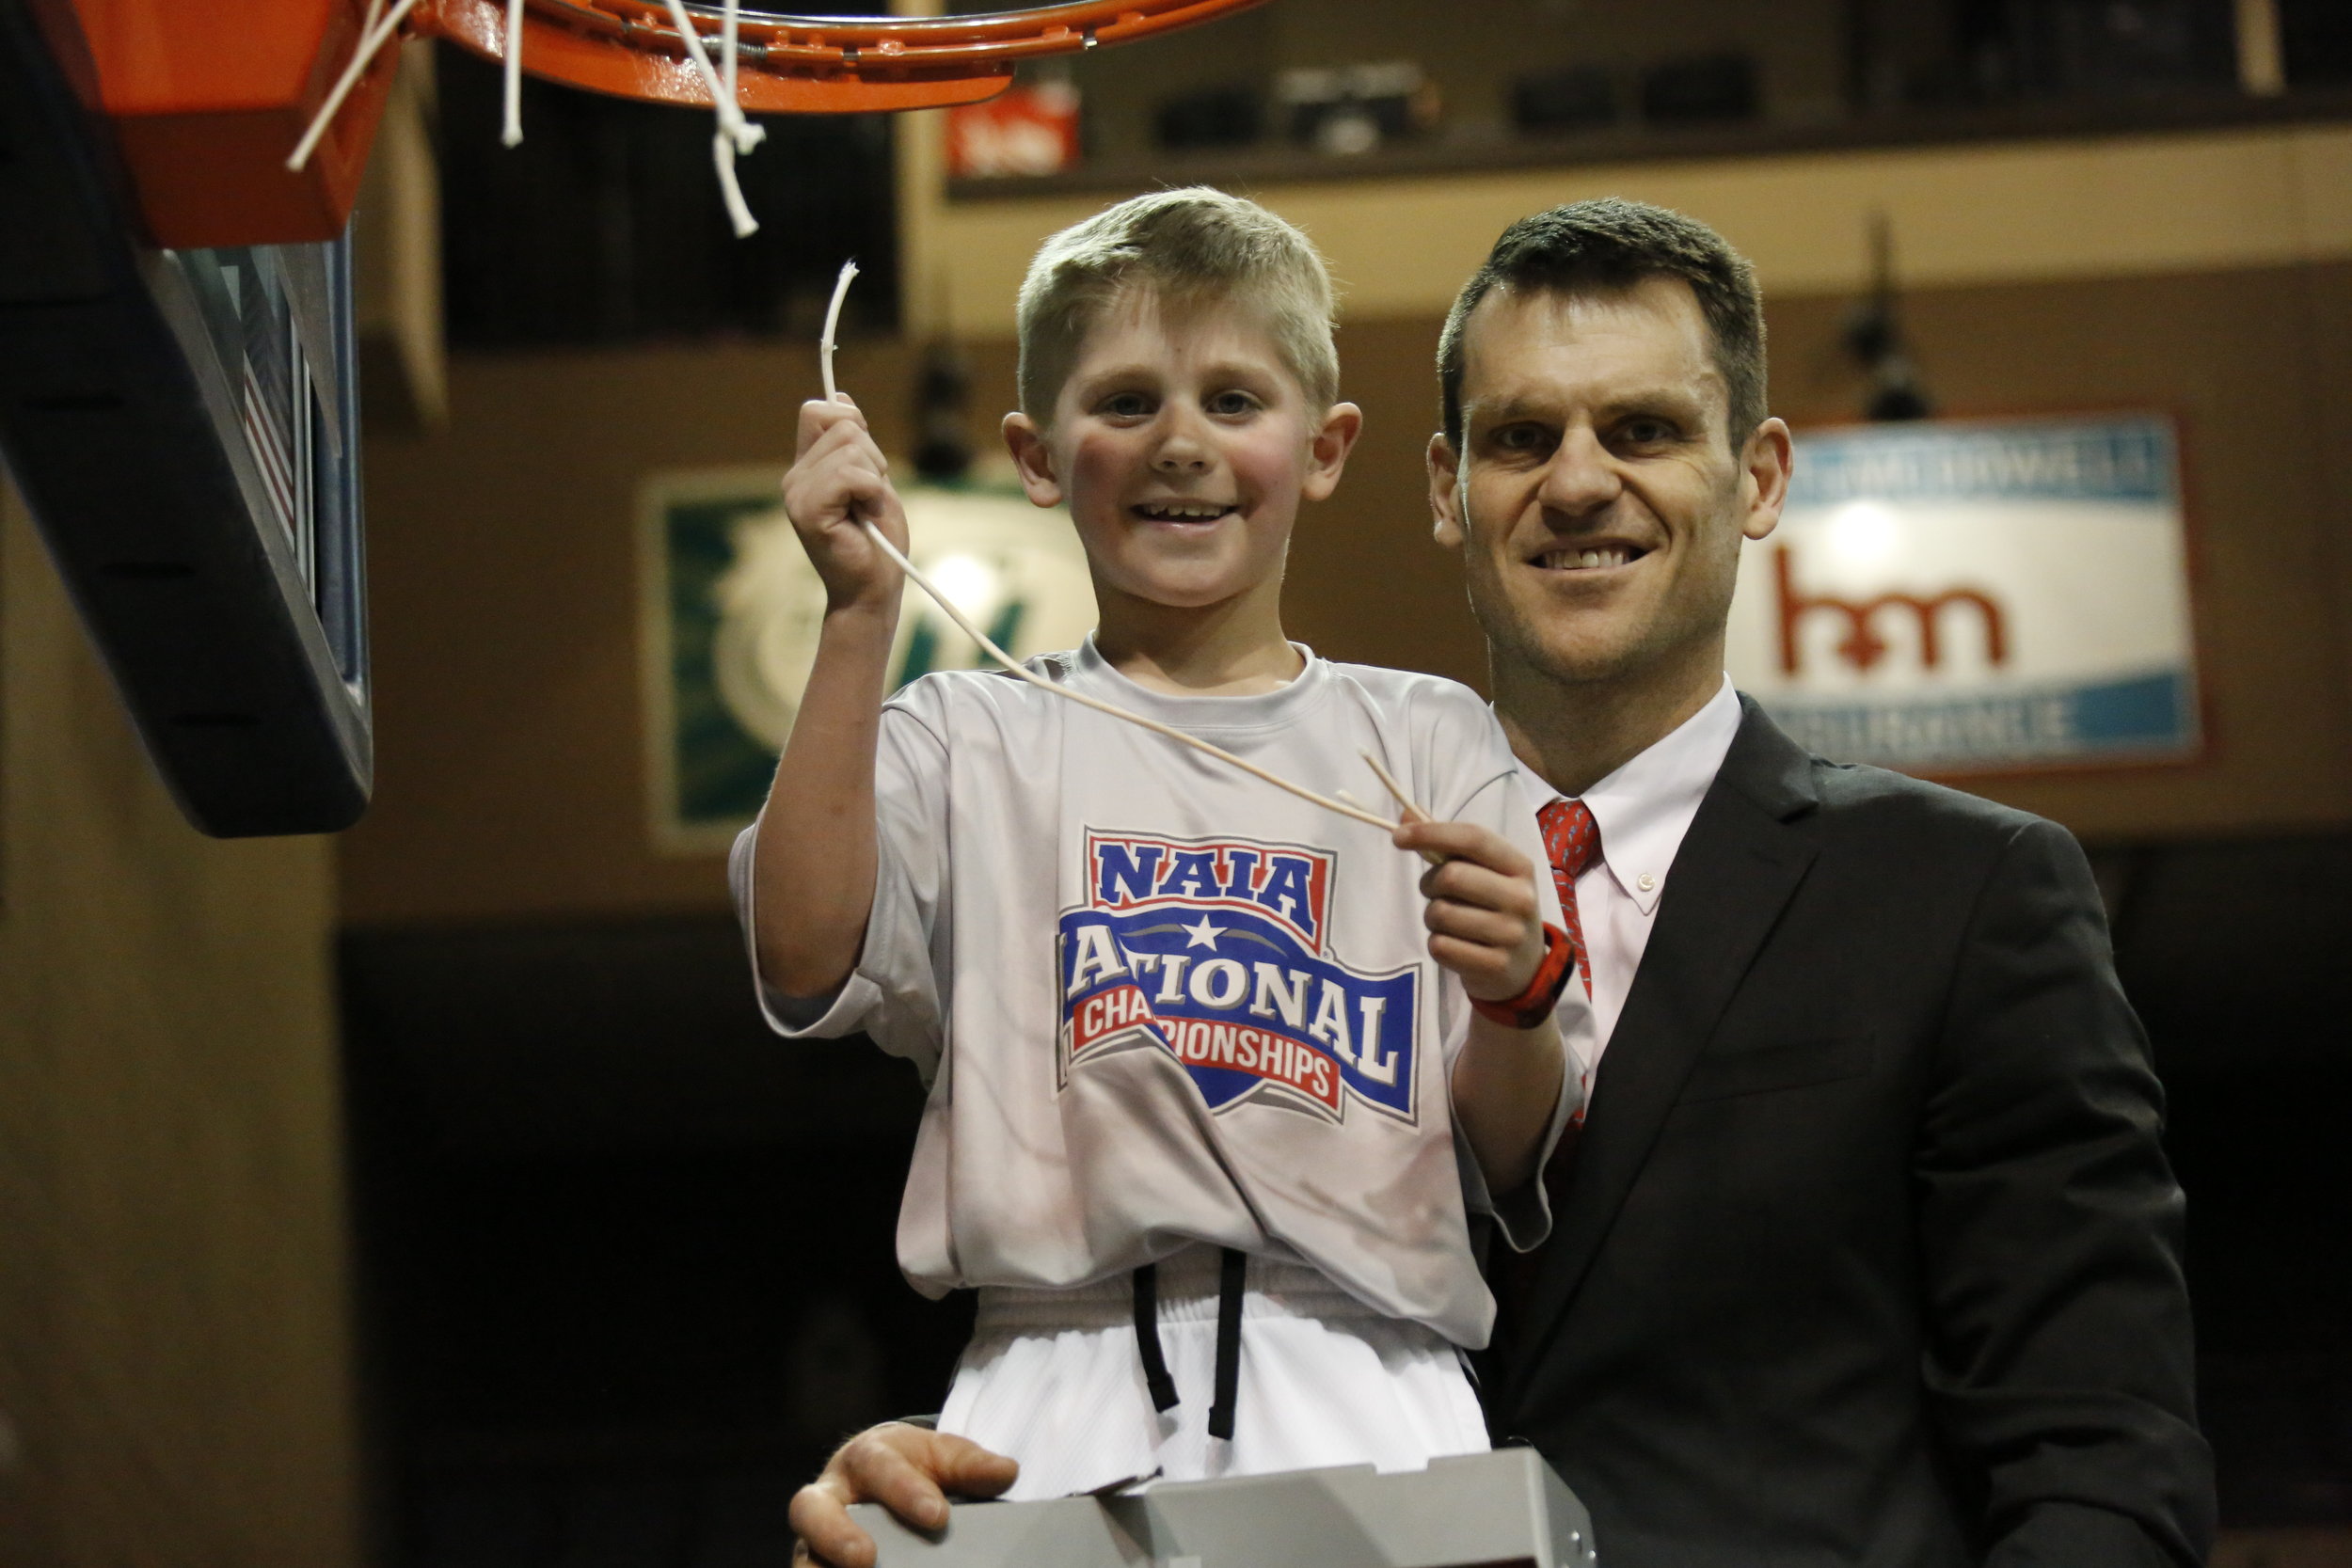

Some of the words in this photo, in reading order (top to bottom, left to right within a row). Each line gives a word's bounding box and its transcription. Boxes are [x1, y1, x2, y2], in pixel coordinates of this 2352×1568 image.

[1098, 843, 1316, 938] NAIA
[1059, 924, 1399, 1087] ATIONAL
[1083, 988, 1329, 1099] CHAPIONSHIPS
